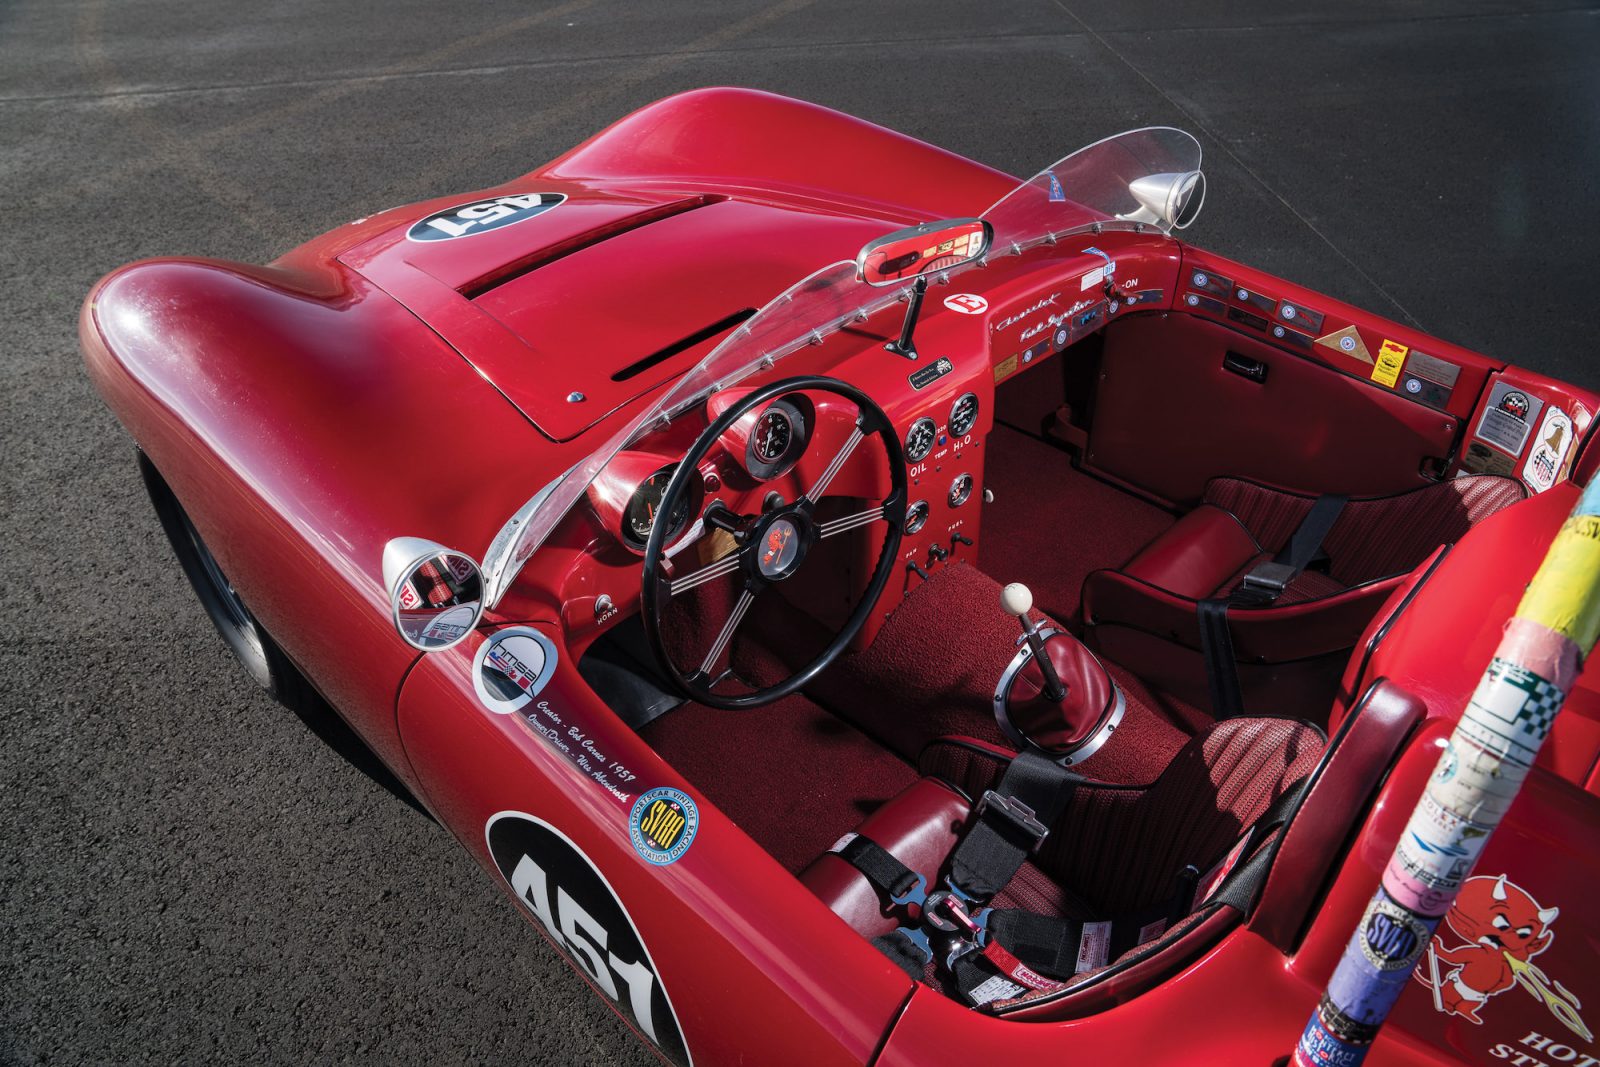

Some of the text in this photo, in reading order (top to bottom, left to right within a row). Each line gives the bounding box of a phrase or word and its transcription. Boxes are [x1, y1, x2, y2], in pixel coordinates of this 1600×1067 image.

[426, 193, 542, 237] 451
[910, 463, 927, 478] OIL
[597, 607, 618, 625] HORN
[528, 714, 570, 753] Owner/Driver
[576, 754, 592, 772] Wes
[537, 701, 562, 725] Creator
[567, 726, 585, 741] Bob
[608, 762, 636, 782] 1959
[632, 790, 696, 857] SPORTSCAR VINTAGE RACING
[632, 829, 669, 861] ASSOCIATION
[640, 800, 685, 849] SVRA
[511, 853, 660, 1047] 451
